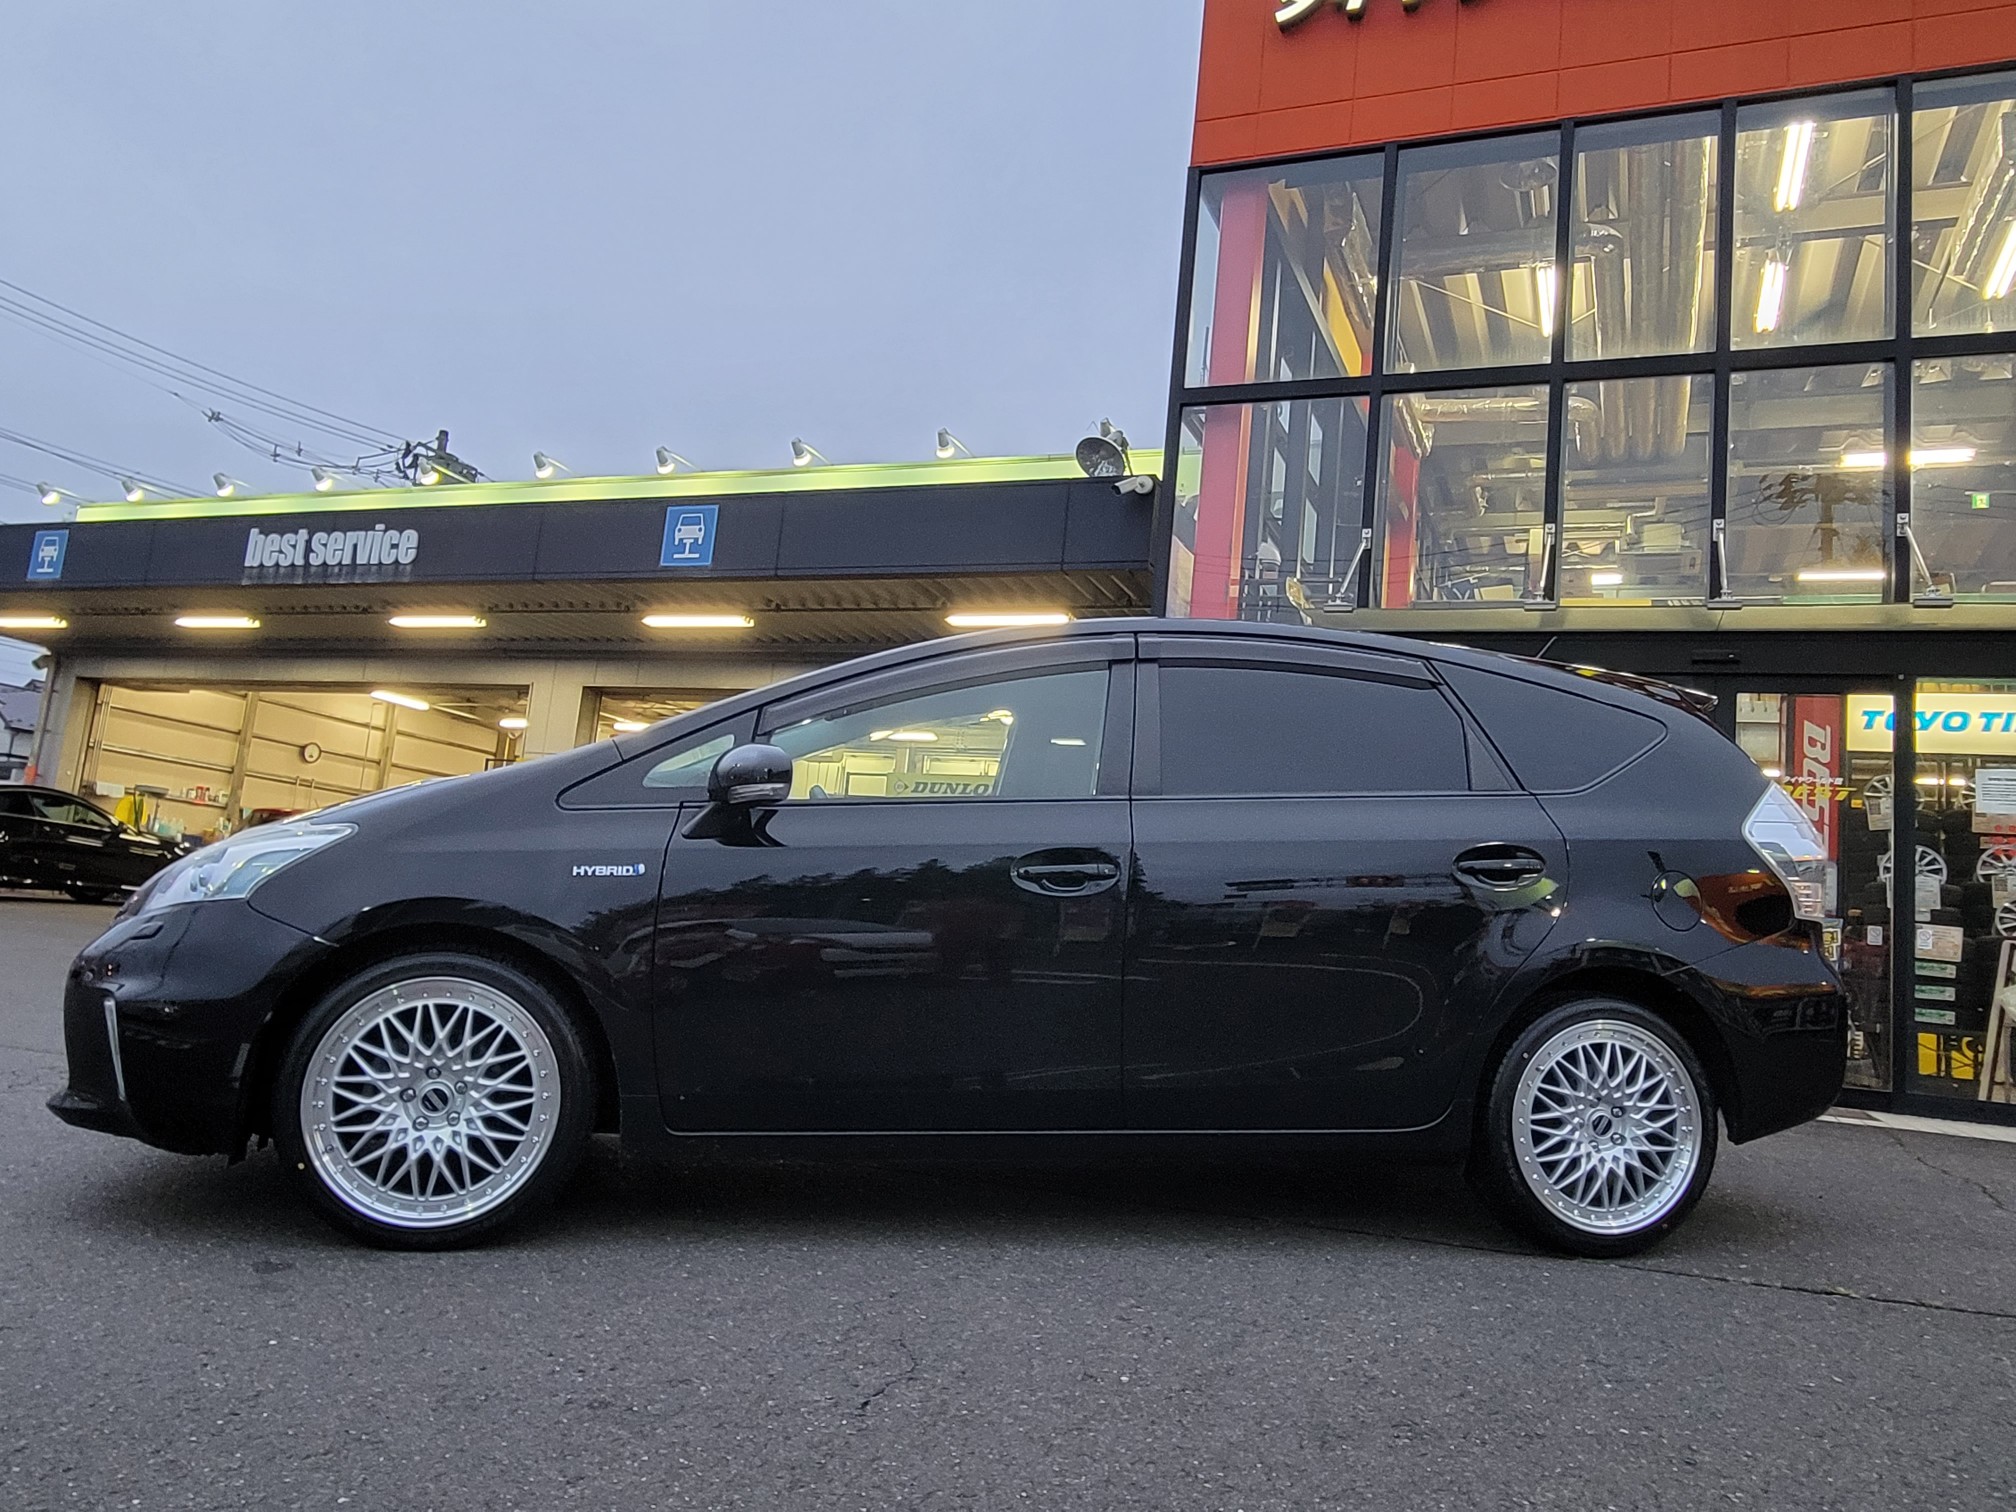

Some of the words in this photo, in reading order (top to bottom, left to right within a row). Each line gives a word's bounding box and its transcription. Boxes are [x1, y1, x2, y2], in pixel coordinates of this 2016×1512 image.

[244, 528, 309, 567] best
[308, 523, 419, 566] service
[1978, 711, 2016, 733] TI
[572, 865, 634, 877] HYBRID
